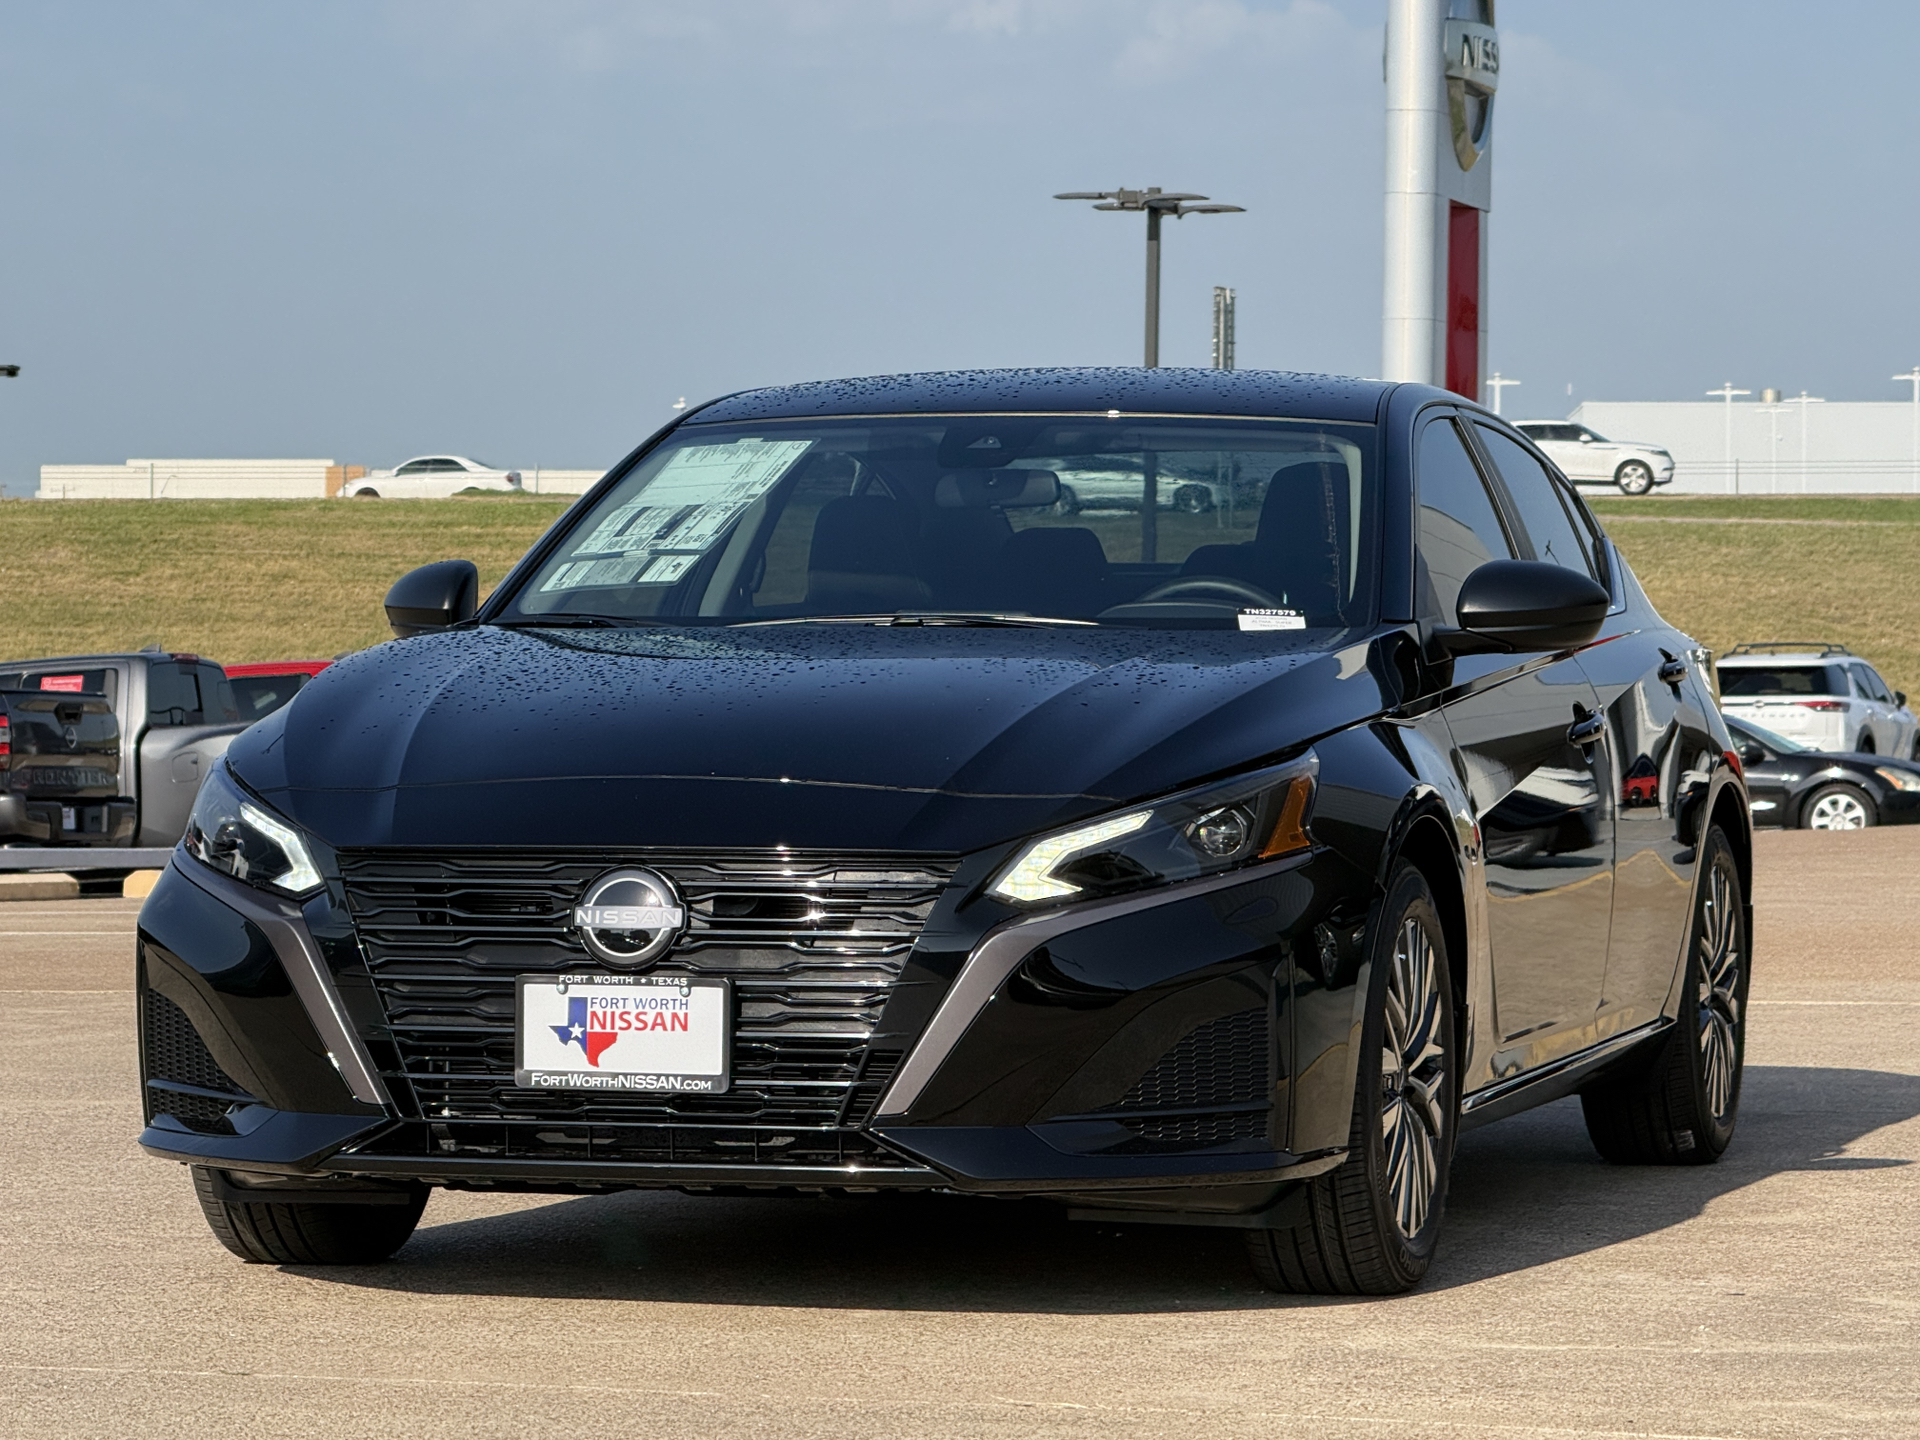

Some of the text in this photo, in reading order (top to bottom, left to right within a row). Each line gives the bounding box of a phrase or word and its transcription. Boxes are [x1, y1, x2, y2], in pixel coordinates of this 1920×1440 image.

[576, 909, 681, 925] NISSAN
[558, 975, 688, 986] FORT WORTH TEXAS
[590, 997, 689, 1010] FORT WORTH
[589, 1010, 689, 1032] NISSAN
